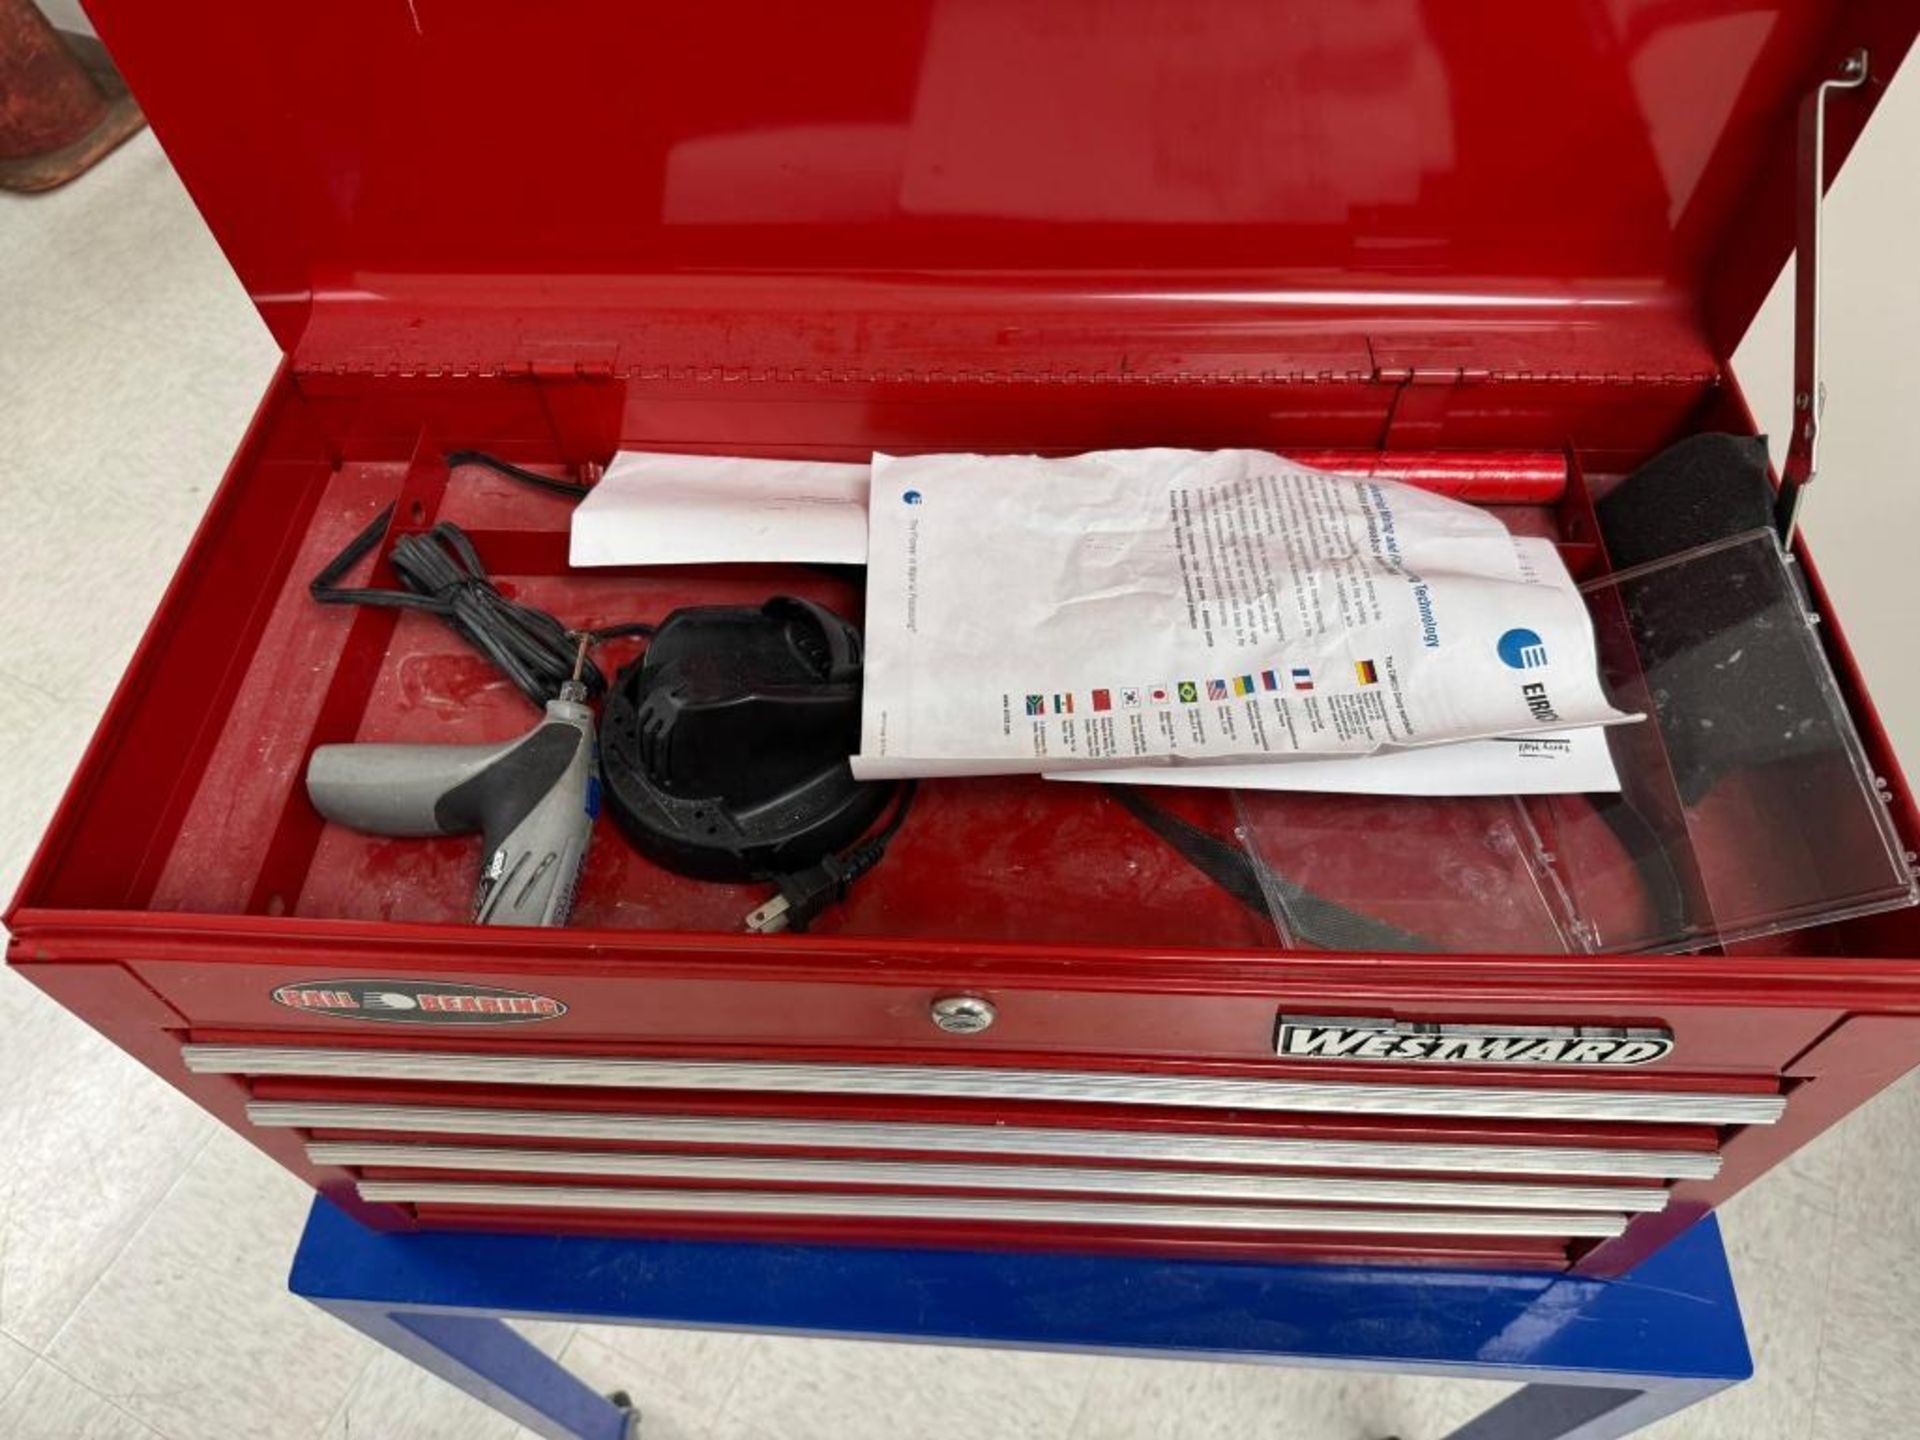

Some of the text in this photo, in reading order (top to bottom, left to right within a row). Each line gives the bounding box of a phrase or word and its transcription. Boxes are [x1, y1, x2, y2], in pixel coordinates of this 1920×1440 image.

[1412, 584, 1441, 648] Technology
[280, 989, 556, 1014] BALL BEARING
[1288, 1027, 1662, 1063] WESTWARD
